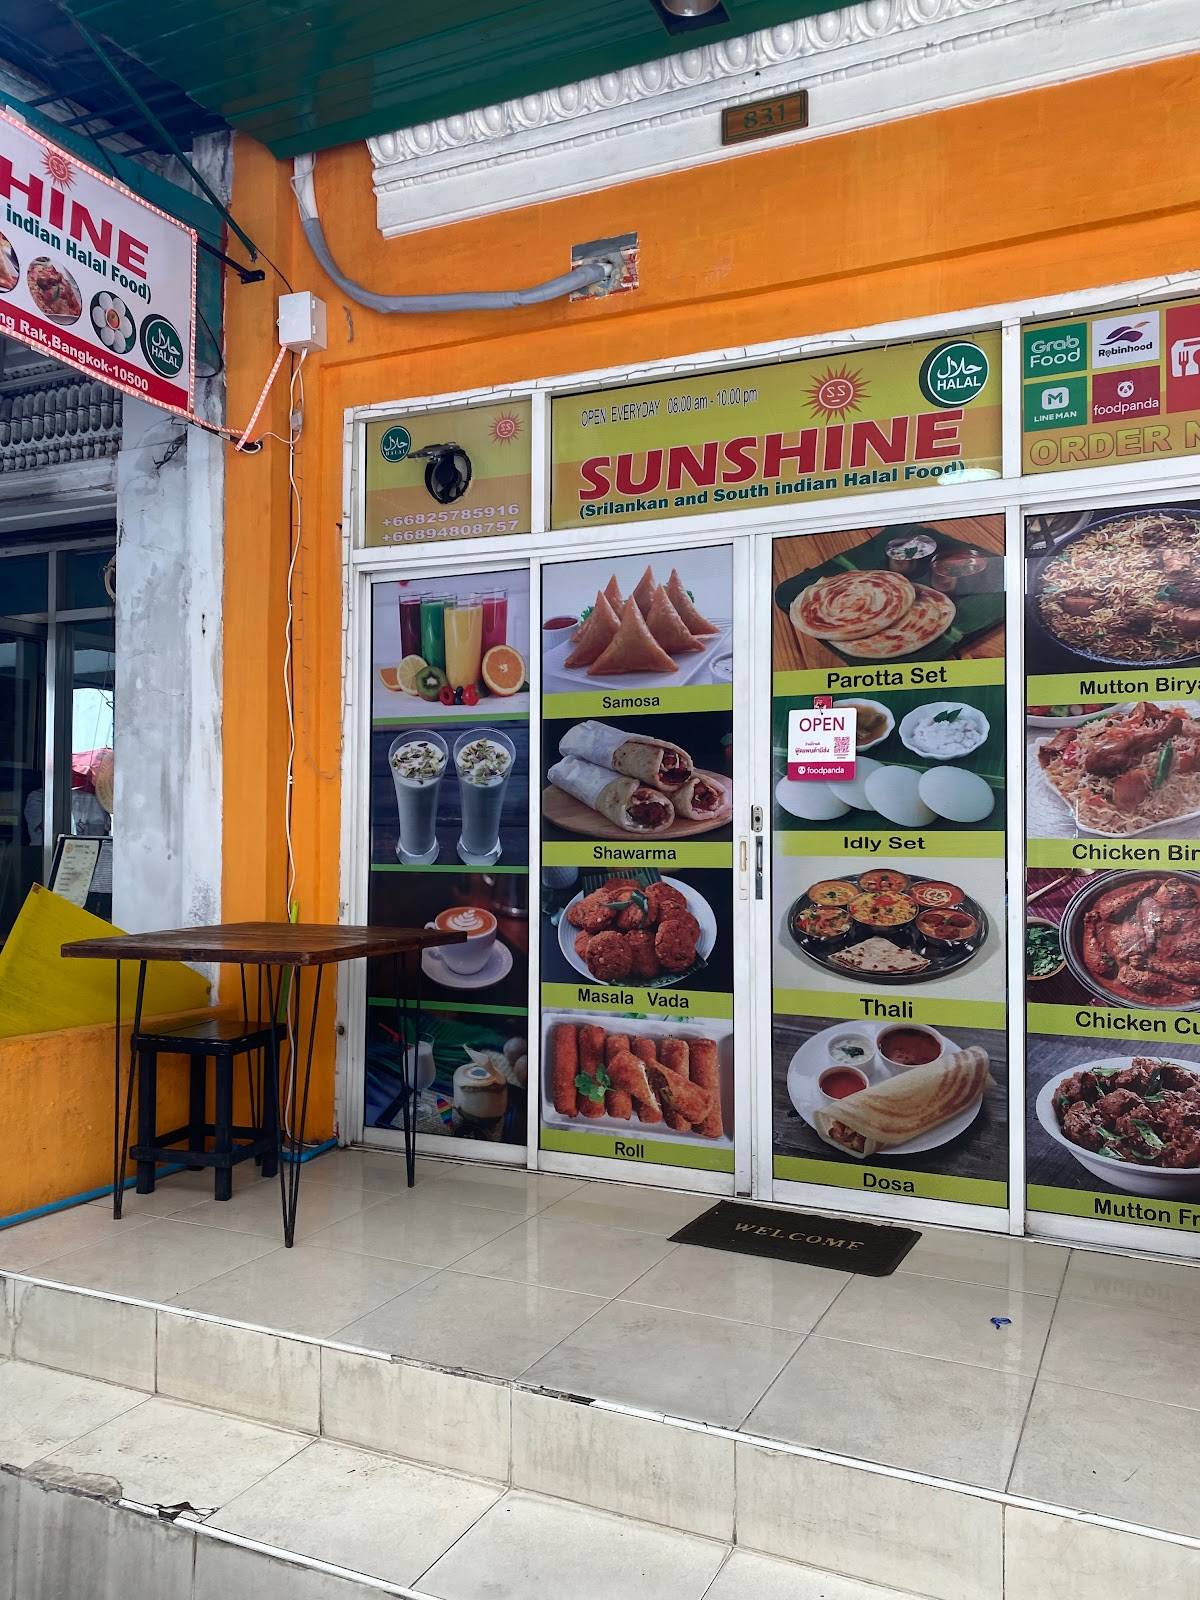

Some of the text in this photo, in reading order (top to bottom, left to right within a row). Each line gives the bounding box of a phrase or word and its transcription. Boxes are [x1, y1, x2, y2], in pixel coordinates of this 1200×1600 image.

[743, 103, 786, 129] 831
[0, 155, 149, 281] HINE
[7, 203, 152, 304] indian Halal Food)
[1031, 336, 1080, 354] Grab
[1098, 342, 1153, 357] Robinhood
[151, 345, 180, 369] HALAL
[937, 356, 983, 379] حلال
[1030, 347, 1081, 368] Food
[937, 376, 981, 391] HALAL
[581, 408, 607, 427] OPEN
[611, 399, 661, 422] EVERYDAY
[694, 396, 708, 410] am
[716, 387, 741, 406] 10.00
[743, 389, 758, 407] pm
[1033, 411, 1077, 423] LINE MAN
[1093, 397, 1159, 416] foodpanda
[578, 408, 964, 502] SUNSHINE
[1030, 425, 1172, 466] ORDER
[579, 460, 965, 520] (Srilankan and South indian Halal Food)
[382, 504, 520, 528] +66825785916
[382, 520, 519, 543] +66894808757
[827, 666, 948, 688] Parotta Set
[1079, 676, 1200, 695] Mutton Biry
[602, 696, 660, 709] Samosa
[799, 716, 845, 732] OPEN
[807, 766, 845, 775] foodpanda
[593, 845, 677, 860] Shawarma
[843, 836, 926, 852] Idly Set
[1072, 843, 1160, 861] Chicken
[578, 988, 689, 1009] Masala Vada
[860, 998, 913, 1018] Thali
[1075, 1010, 1167, 1033] Chicken
[614, 1142, 644, 1158] Roll
[863, 1172, 915, 1193] Dosa
[1094, 1198, 1171, 1223] Mutton
[735, 1222, 865, 1251] WELCOME
